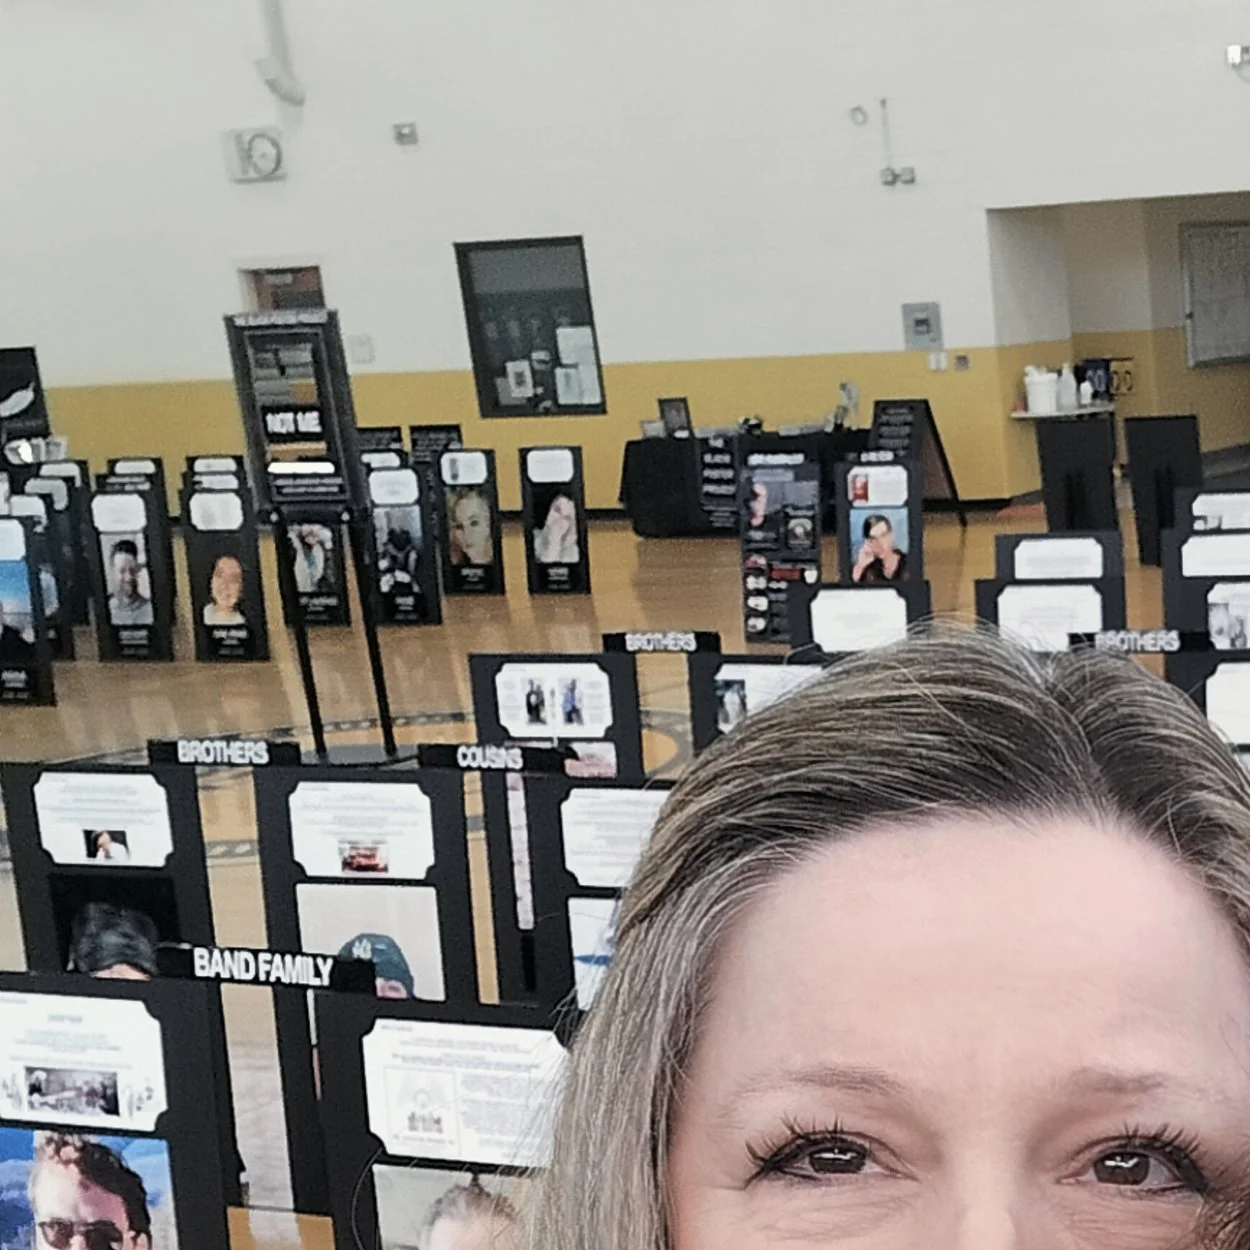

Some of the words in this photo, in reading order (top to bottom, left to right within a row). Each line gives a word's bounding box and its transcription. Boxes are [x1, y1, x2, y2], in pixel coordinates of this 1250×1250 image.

[625, 632, 697, 652] BROTHERS
[177, 740, 270, 764] BROTHERS
[456, 744, 524, 770] COUSINS
[193, 947, 256, 981] BAND
[257, 951, 334, 987] FAMILY
